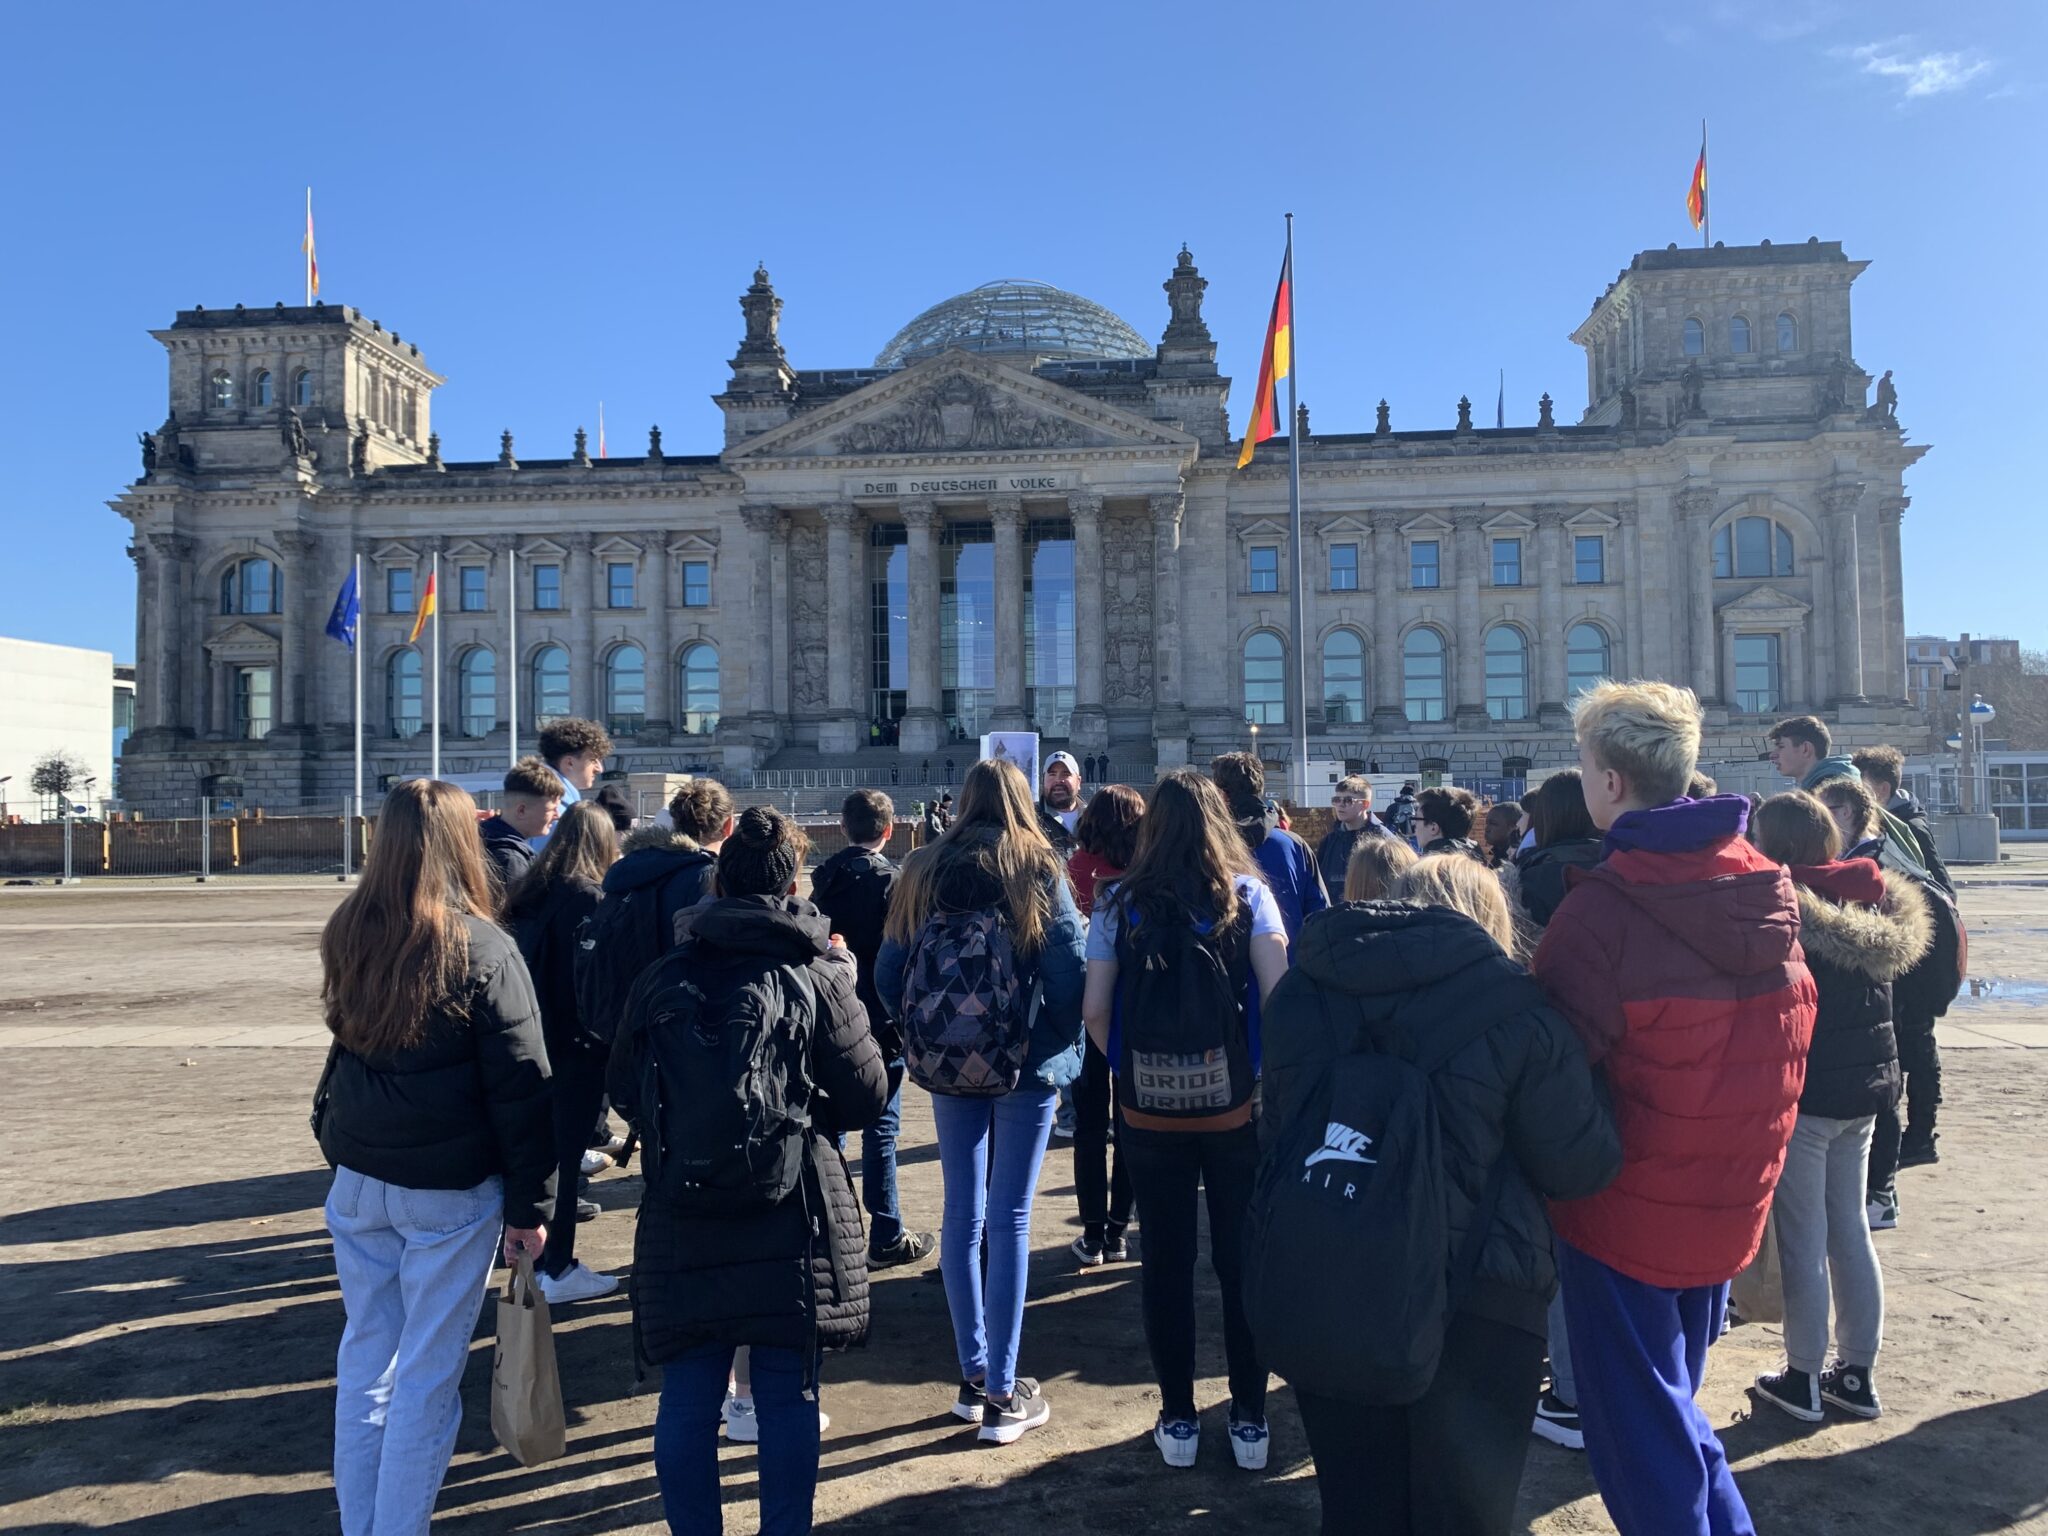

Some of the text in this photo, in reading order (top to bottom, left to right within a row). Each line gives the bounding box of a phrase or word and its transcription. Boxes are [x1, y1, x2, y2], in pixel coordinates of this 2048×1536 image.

[864, 477, 1056, 494] DEM DEUTSCHEN VOLKE
[1140, 1067, 1225, 1090] BRIDE
[1324, 1122, 1373, 1158] NIKE
[1302, 1169, 1356, 1200] AIR
